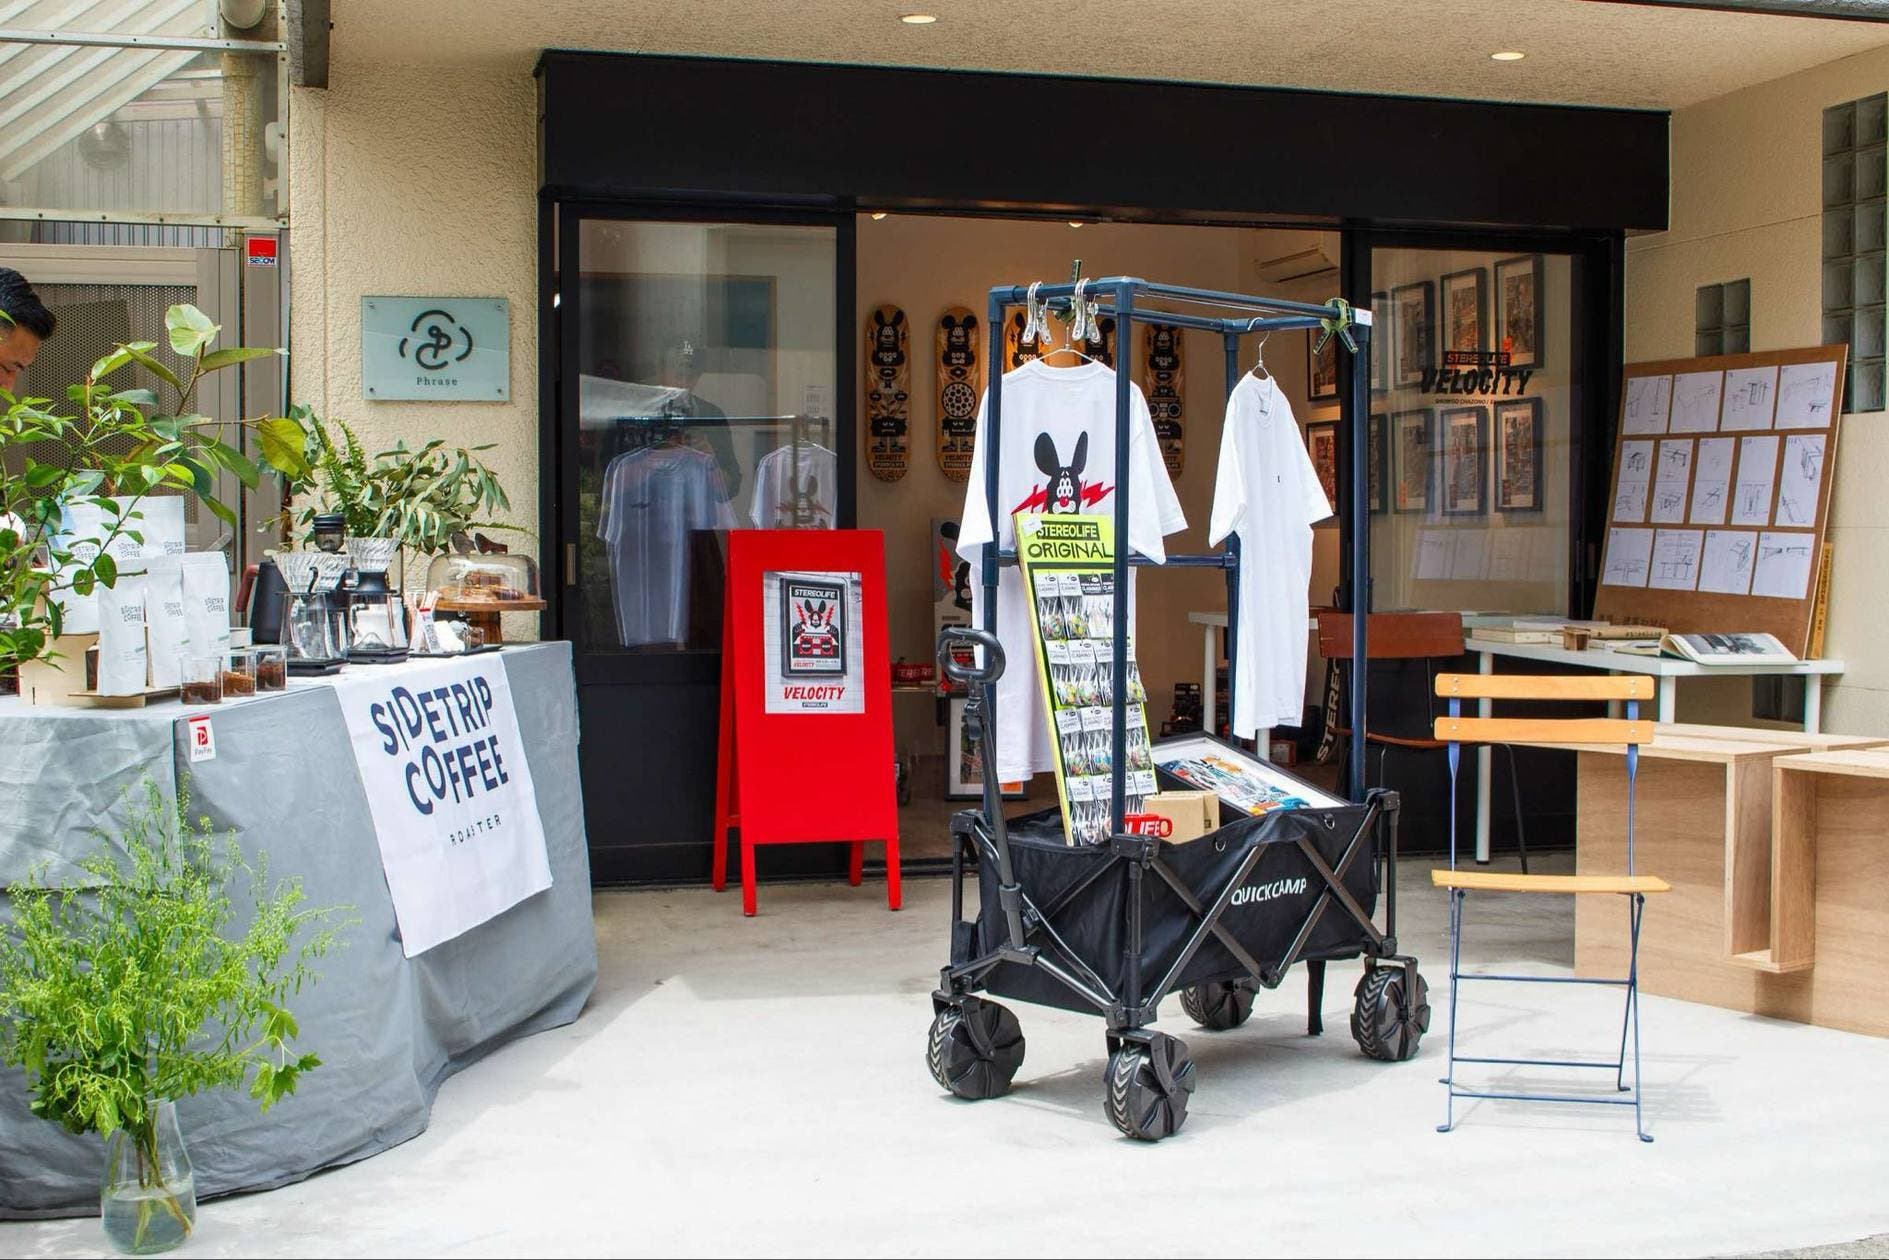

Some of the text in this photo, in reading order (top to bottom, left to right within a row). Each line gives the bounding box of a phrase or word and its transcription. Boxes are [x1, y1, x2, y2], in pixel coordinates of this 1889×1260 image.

[416, 376, 458, 386] Phrase
[1420, 368, 1533, 395] VELOCITY
[1037, 523, 1098, 538] STEREOLIFE
[1028, 542, 1114, 559] ORIGINAL
[794, 589, 836, 599] STEREOLIFE
[784, 686, 846, 700] VELOCITY
[370, 676, 493, 756] SIDETRIP
[405, 735, 509, 815] COFFEE
[450, 814, 502, 846] ROASTER
[1231, 877, 1307, 906] QUICKCAMP
